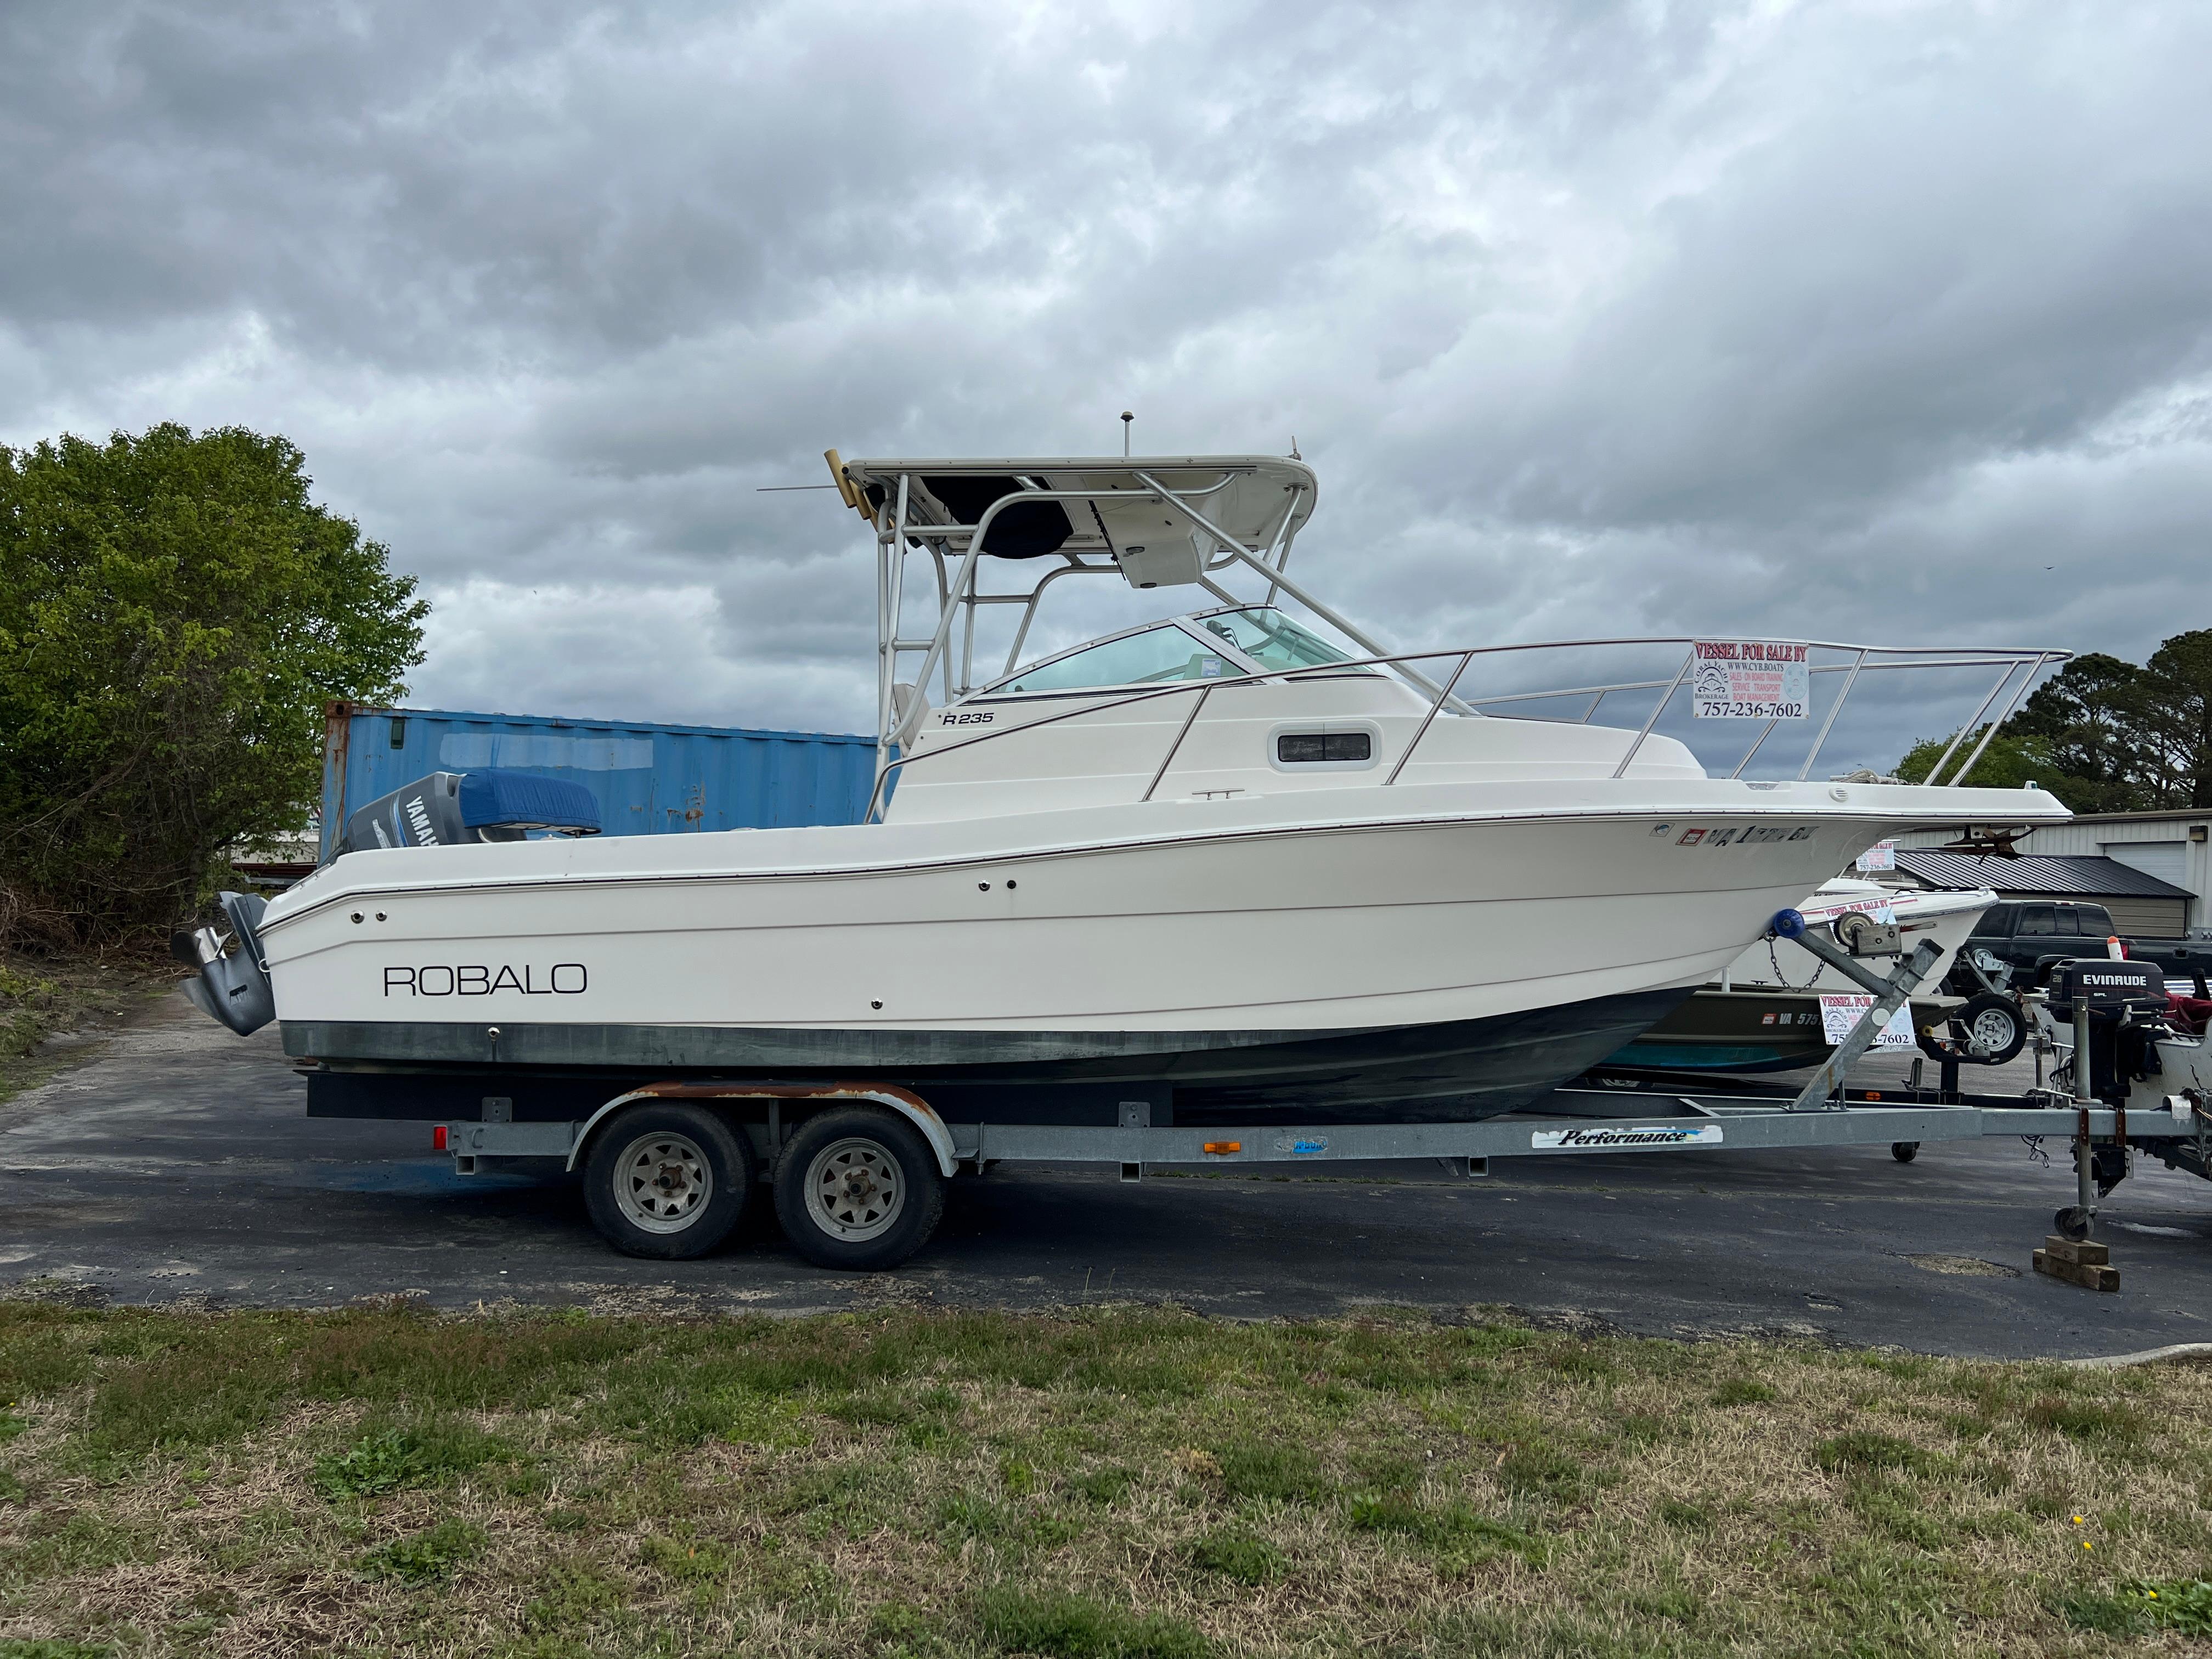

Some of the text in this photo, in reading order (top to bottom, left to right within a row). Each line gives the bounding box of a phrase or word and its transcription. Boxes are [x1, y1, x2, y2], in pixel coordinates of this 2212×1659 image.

[1696, 642, 1807, 662] VESSEL FOR SALE BY
[1695, 661, 1728, 684] CORAL YACHT
[1728, 663, 1784, 672] WWW.CYB.BOATS
[1729, 672, 1742, 681] SALES
[1732, 682, 1781, 692] SERVICE TRANSPORT
[1733, 693, 1780, 702] BOAT MANAGEMENT
[1702, 702, 1802, 717] 757-236-7602
[406, 795, 439, 846] YAMAH
[1849, 903, 1863, 912] FOR
[1863, 901, 1880, 910] SALE
[1879, 900, 1888, 908] BY
[384, 963, 587, 996] ROBALO
[2053, 974, 2147, 986] 28 EVINRUDE
[1821, 996, 1854, 1007] VESSEL
[1854, 996, 1871, 1007] FOR
[1779, 1013, 1792, 1024] VA
[1559, 1130, 1687, 1146] Performance
